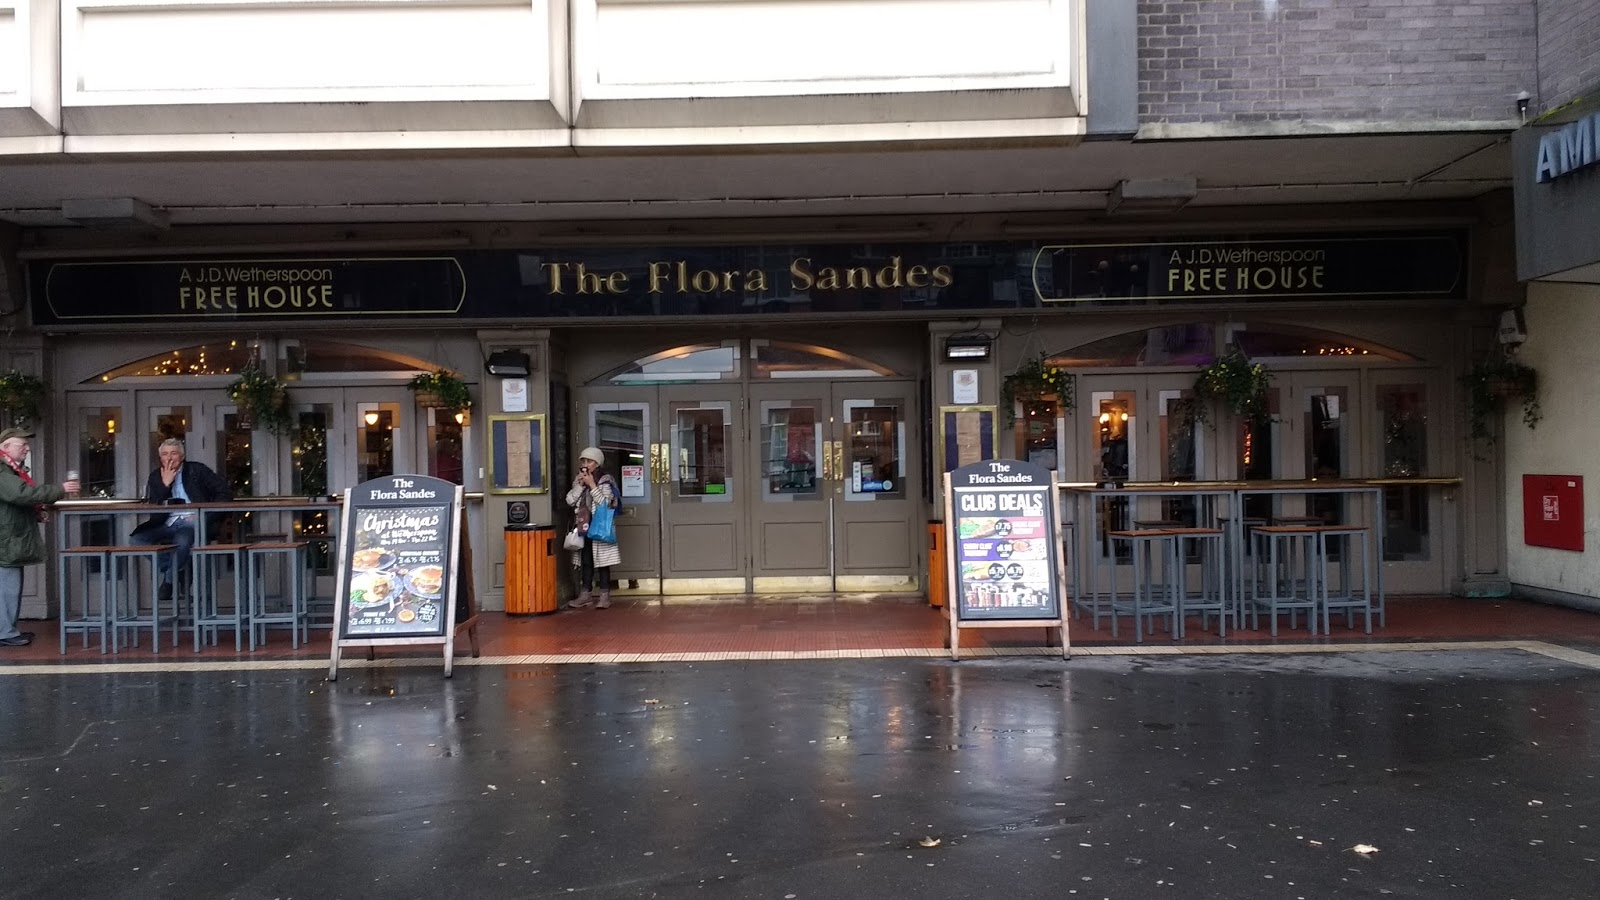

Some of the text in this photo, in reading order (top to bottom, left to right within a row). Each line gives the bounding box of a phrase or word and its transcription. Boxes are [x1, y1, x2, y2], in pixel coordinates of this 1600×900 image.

[1168, 249, 1182, 265] A
[179, 267, 192, 283] A
[540, 255, 953, 295] The Flora Sandes
[1168, 266, 1324, 291] FREE HOUSE
[179, 285, 333, 310] FREE HOUSE
[989, 462, 1011, 473] The
[392, 478, 414, 489] The
[968, 473, 1033, 484] Flora Sandes
[370, 488, 436, 500] Flora Sandes
[961, 493, 1043, 512] CLUB DEALS
[363, 512, 440, 534] Christmas
